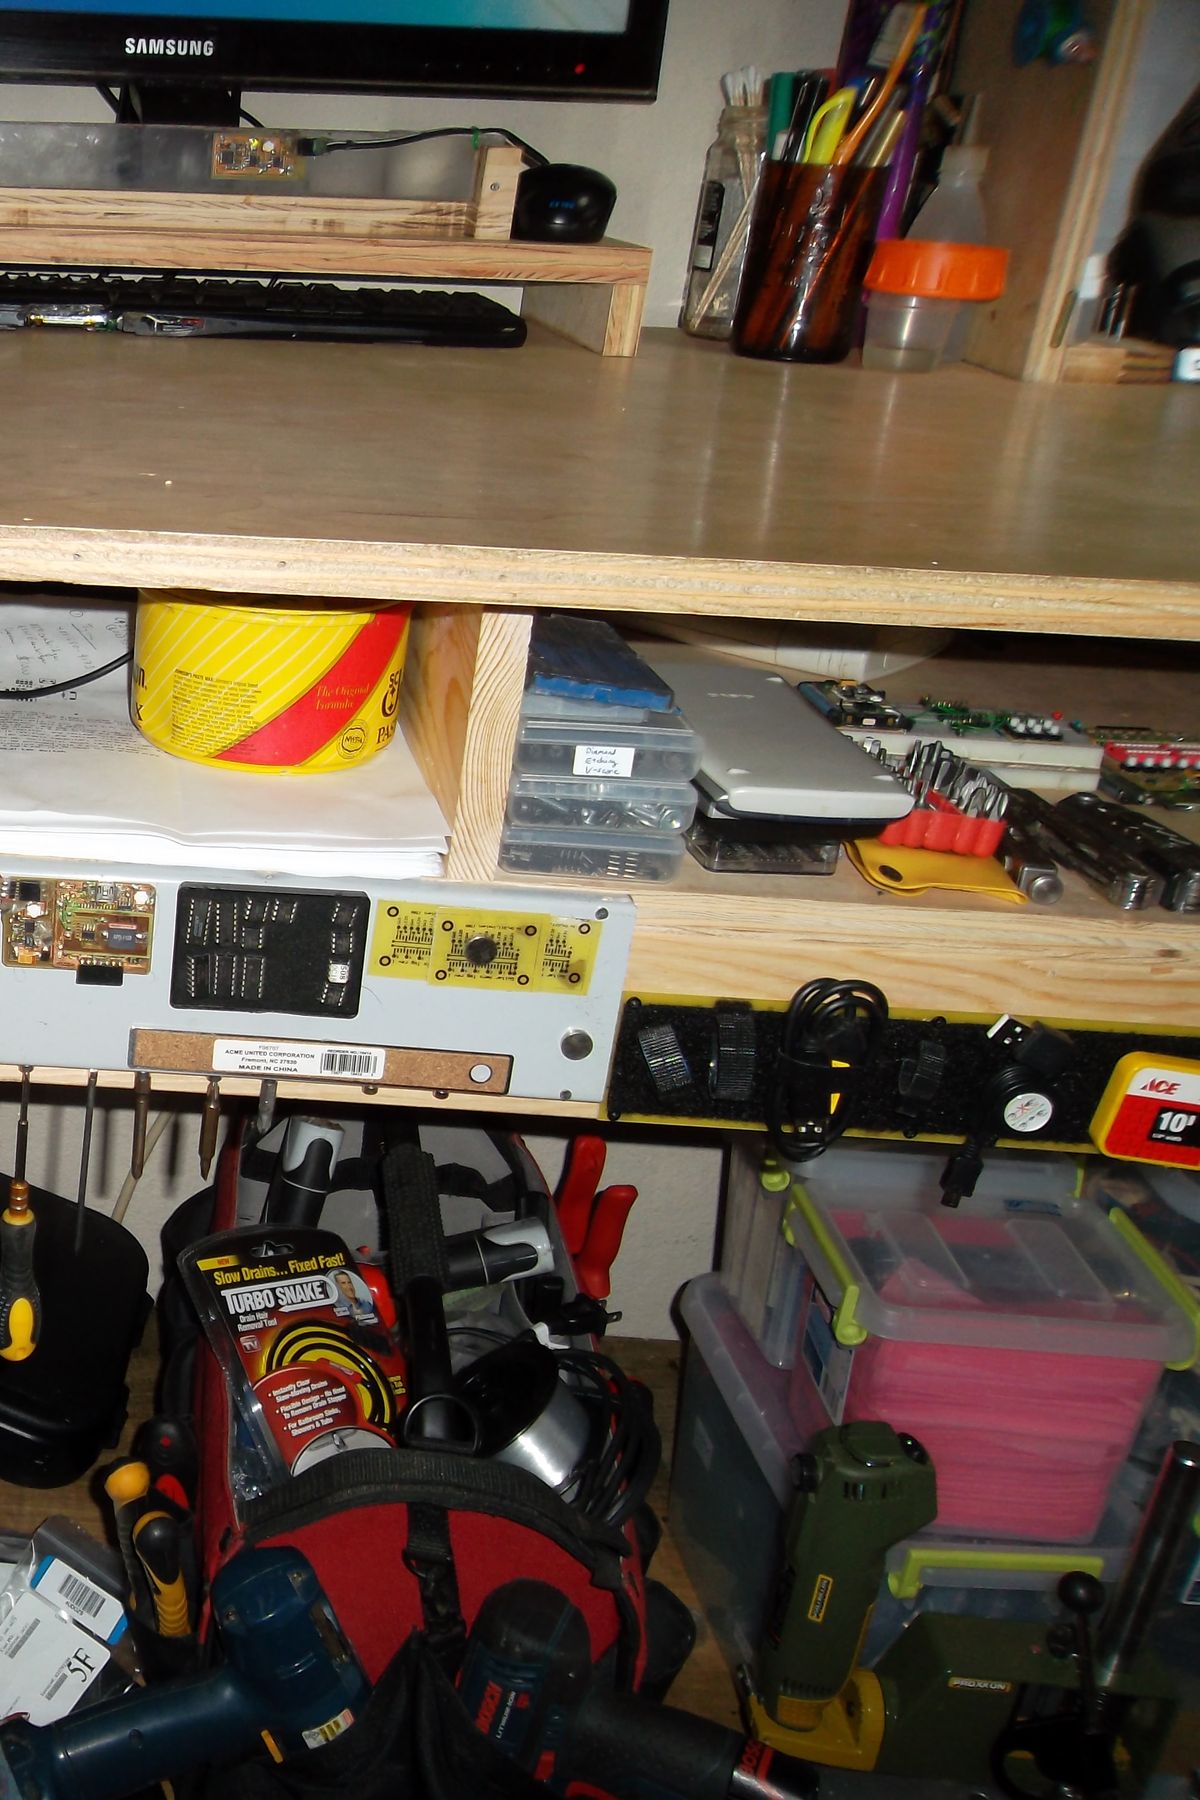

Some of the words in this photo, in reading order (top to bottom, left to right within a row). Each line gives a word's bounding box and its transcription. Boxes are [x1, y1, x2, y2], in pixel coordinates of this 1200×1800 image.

[125, 37, 214, 56] SAMSUNG
[317, 685, 331, 697] The
[336, 682, 370, 697] Original
[1140, 1077, 1181, 1096] ACE
[213, 1269, 241, 1286] Slow
[242, 1264, 289, 1281] Drains...
[288, 1258, 318, 1274] Fixed
[318, 1252, 346, 1269] Fast!
[221, 1289, 276, 1315] TURBO
[275, 1280, 324, 1306] SNAKE
[237, 1319, 264, 1333] Removal
[263, 1317, 278, 1328] Tool
[239, 1313, 258, 1324] Drain
[257, 1311, 269, 1320] Hair
[287, 1422, 297, 1430] For
[68, 1647, 97, 1684] 5F
